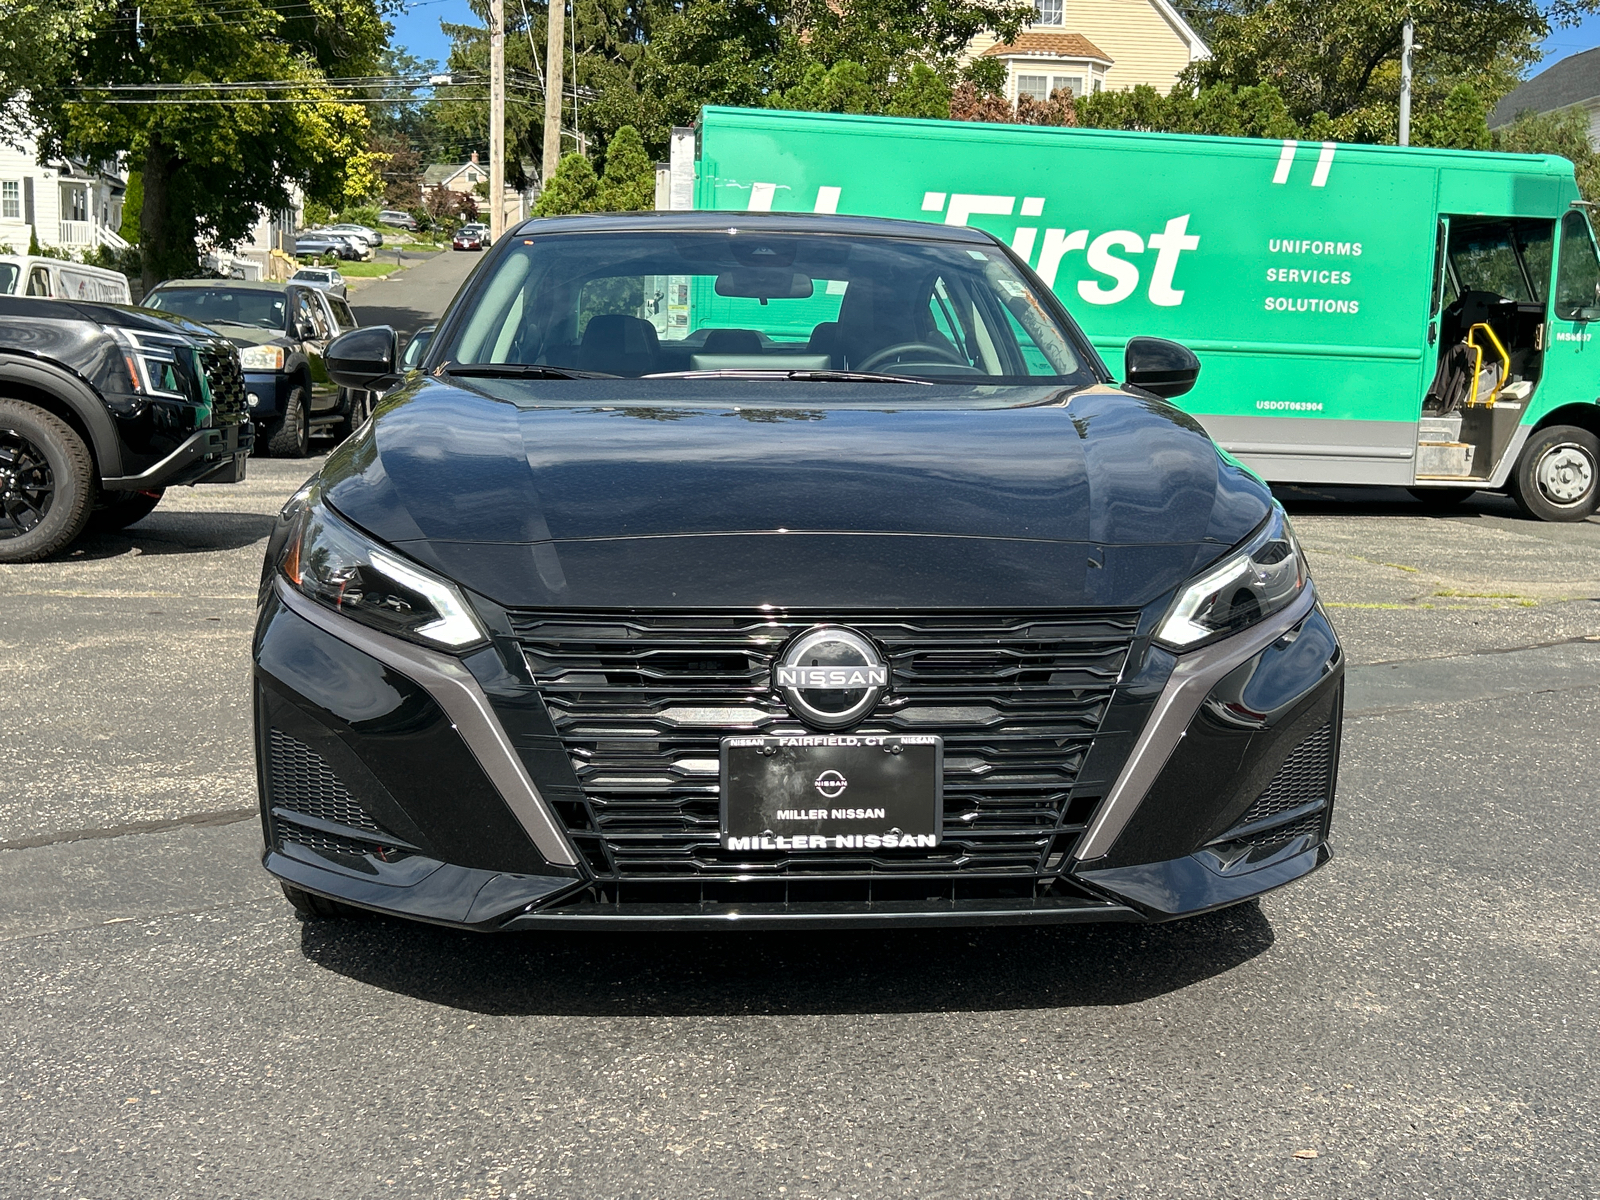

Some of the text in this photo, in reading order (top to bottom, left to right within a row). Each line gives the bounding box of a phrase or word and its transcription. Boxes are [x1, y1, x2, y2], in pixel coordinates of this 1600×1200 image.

[1268, 239, 1362, 256] UNIFORMS
[1266, 268, 1351, 285] SERVICES
[1264, 297, 1359, 314] SOLUTIONS
[1256, 400, 1323, 411] USDOT063904
[779, 670, 885, 685] NISSAN
[730, 739, 764, 747] NISSAN
[780, 736, 886, 747] FAIRFIELD, CT
[901, 737, 935, 745] NISSAN
[814, 779, 848, 788] NISSAN
[776, 808, 885, 820] MILLER NISSAN
[728, 833, 936, 850] MILLER NISSAN
